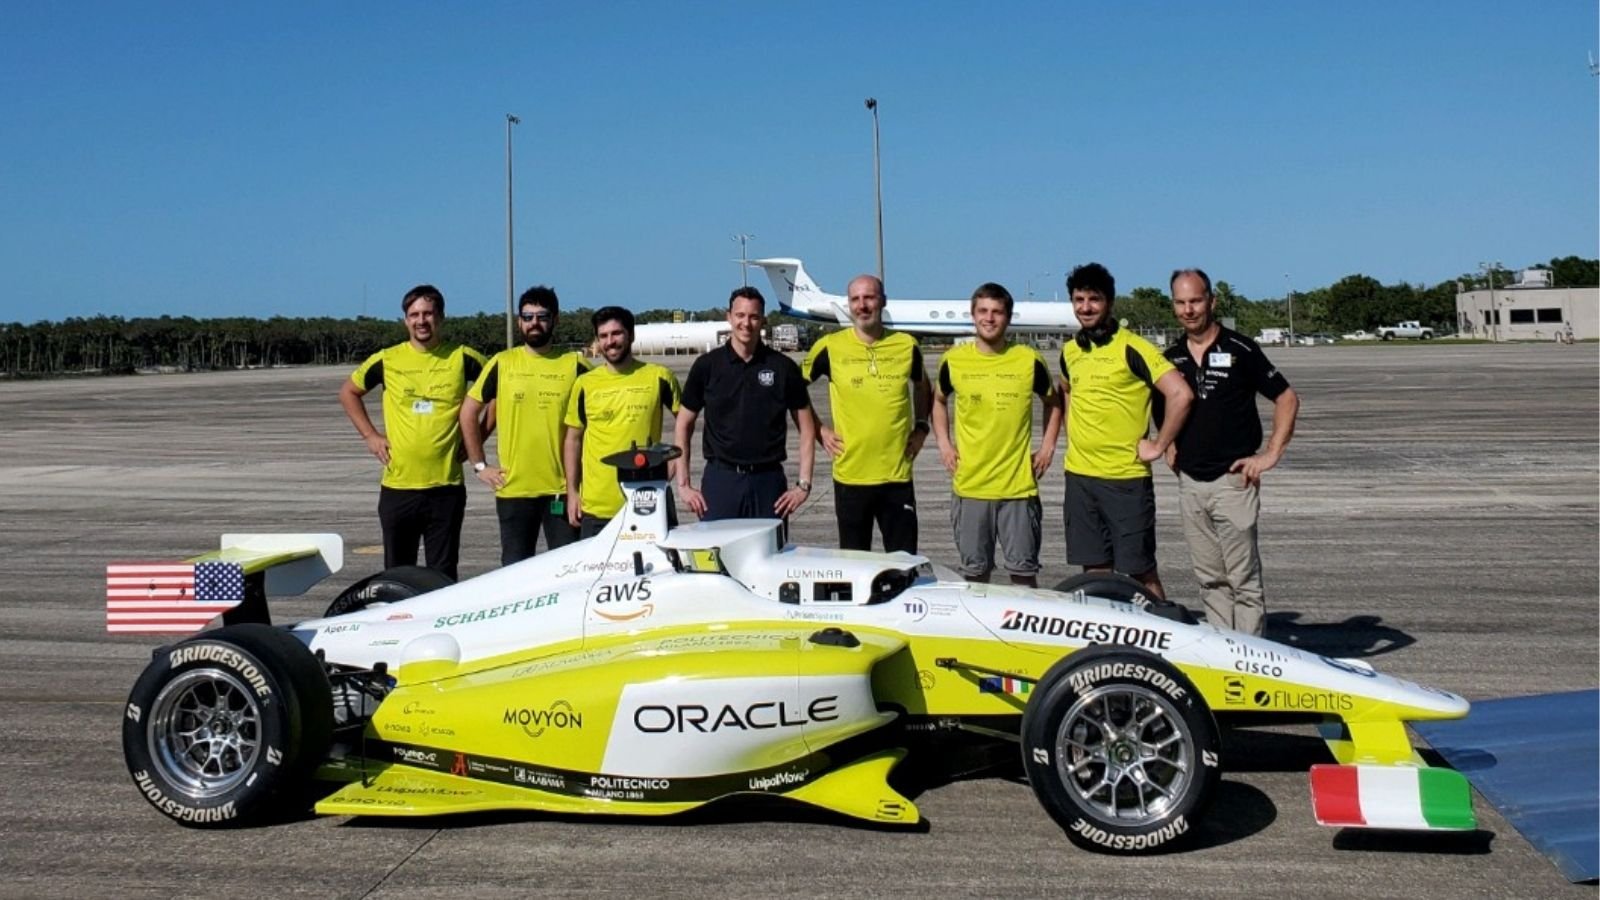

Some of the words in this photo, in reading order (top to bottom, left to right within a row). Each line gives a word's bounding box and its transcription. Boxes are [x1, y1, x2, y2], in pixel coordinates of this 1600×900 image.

[786, 568, 843, 579] LUMINAR
[595, 578, 652, 604] aws
[433, 591, 560, 628] SCHAEFFLER
[903, 602, 923, 614] TII
[1001, 609, 1173, 650] BRIDGESTONE
[169, 644, 273, 697] BRIDGESTONE
[1069, 662, 1187, 701] BRIDGESTONE
[1234, 660, 1283, 677] CISCO
[633, 694, 839, 733] ORACLE
[1274, 690, 1354, 711] fluentis
[502, 708, 583, 729] MOVYON
[590, 775, 671, 790] POLITECNICO
[590, 788, 625, 799] MILANO
[133, 769, 237, 823] BRIDGESTONE
[1069, 813, 1190, 851] BRIDGESTONE
